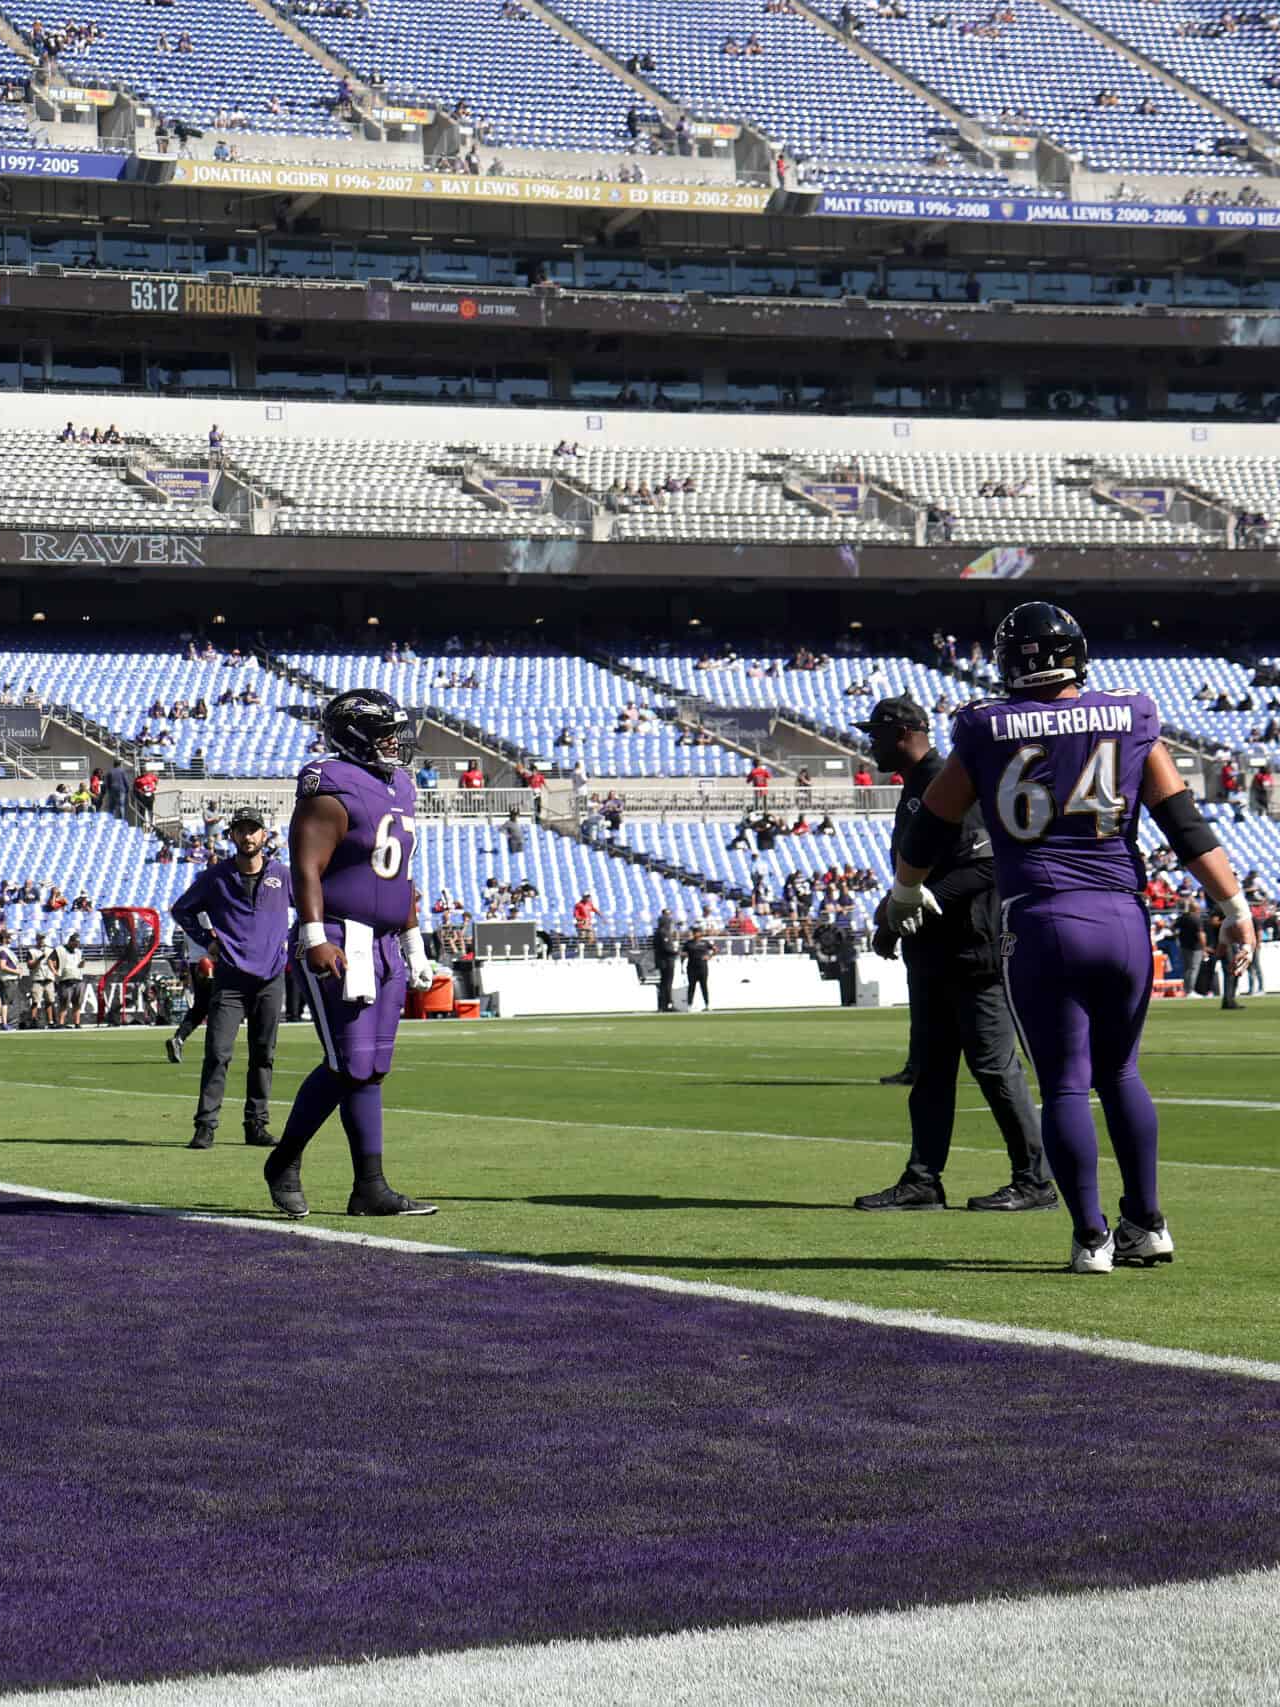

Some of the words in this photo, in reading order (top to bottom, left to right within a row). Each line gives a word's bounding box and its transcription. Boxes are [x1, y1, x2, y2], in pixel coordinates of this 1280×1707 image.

[0, 155, 79, 174] 1997-2005
[192, 166, 271, 185] JONATHAN
[276, 170, 328, 187] OGDEN
[334, 173, 413, 191] 1996-2007
[442, 180, 470, 194] RAY
[475, 181, 519, 197] LEWIS
[525, 183, 601, 201] 1996-2012
[629, 189, 648, 203] ED
[652, 190, 689, 205] REED
[824, 197, 861, 212] MATT
[864, 198, 915, 214] STOVER
[919, 201, 990, 218] 1996-2008
[1026, 205, 1069, 222] JAMAL
[1073, 207, 1114, 222] LEWIS
[1116, 208, 1187, 224] 2000-2006
[1218, 210, 1254, 224] TODD
[131, 281, 179, 311] 53:12
[184, 284, 262, 314] PREGAME
[411, 302, 459, 313] MARYLAND
[478, 305, 516, 315] LOTTERY
[20, 532, 206, 566] RAVEN
[7, 727, 39, 737] Health
[991, 705, 1132, 741] LINDERBAUM
[997, 738, 1126, 840] 64
